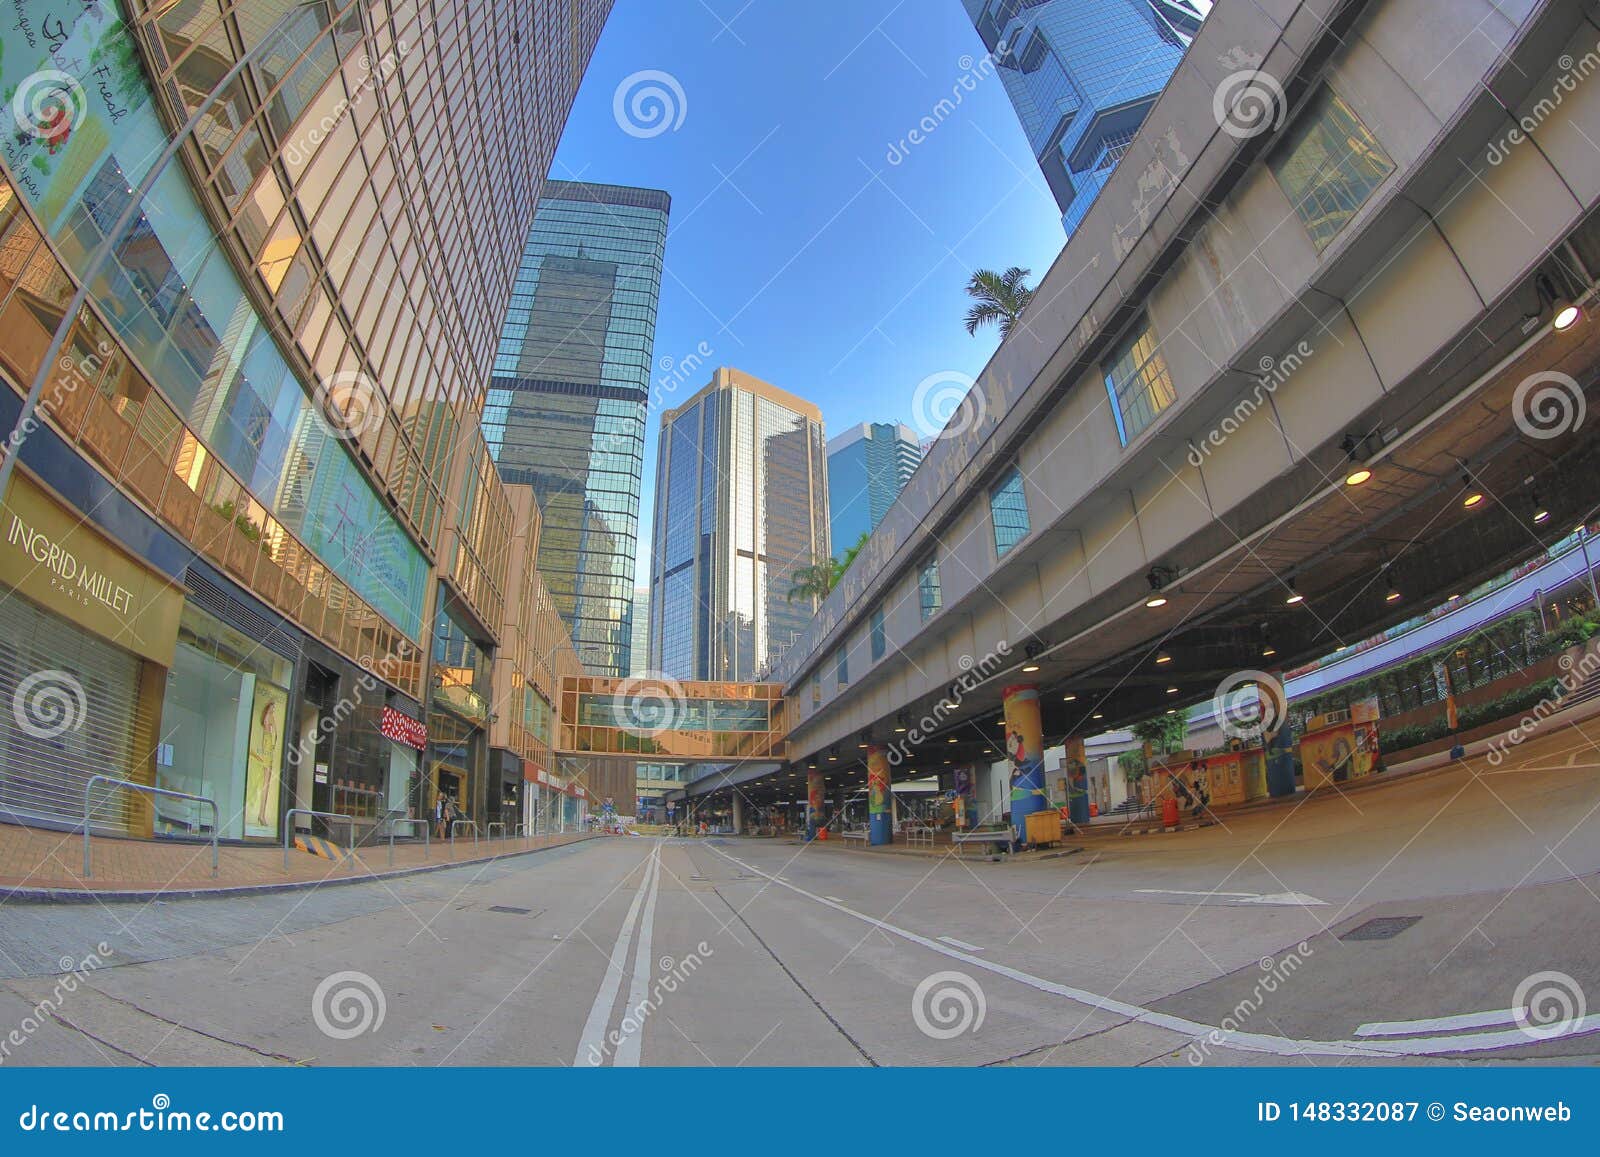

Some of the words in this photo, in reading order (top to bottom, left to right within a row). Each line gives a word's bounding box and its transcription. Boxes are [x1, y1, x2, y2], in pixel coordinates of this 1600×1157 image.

[93, 64, 128, 125] Fresh
[8, 515, 77, 580] INGRID
[77, 565, 134, 615] MILLET
[51, 578, 89, 608] PARIS
